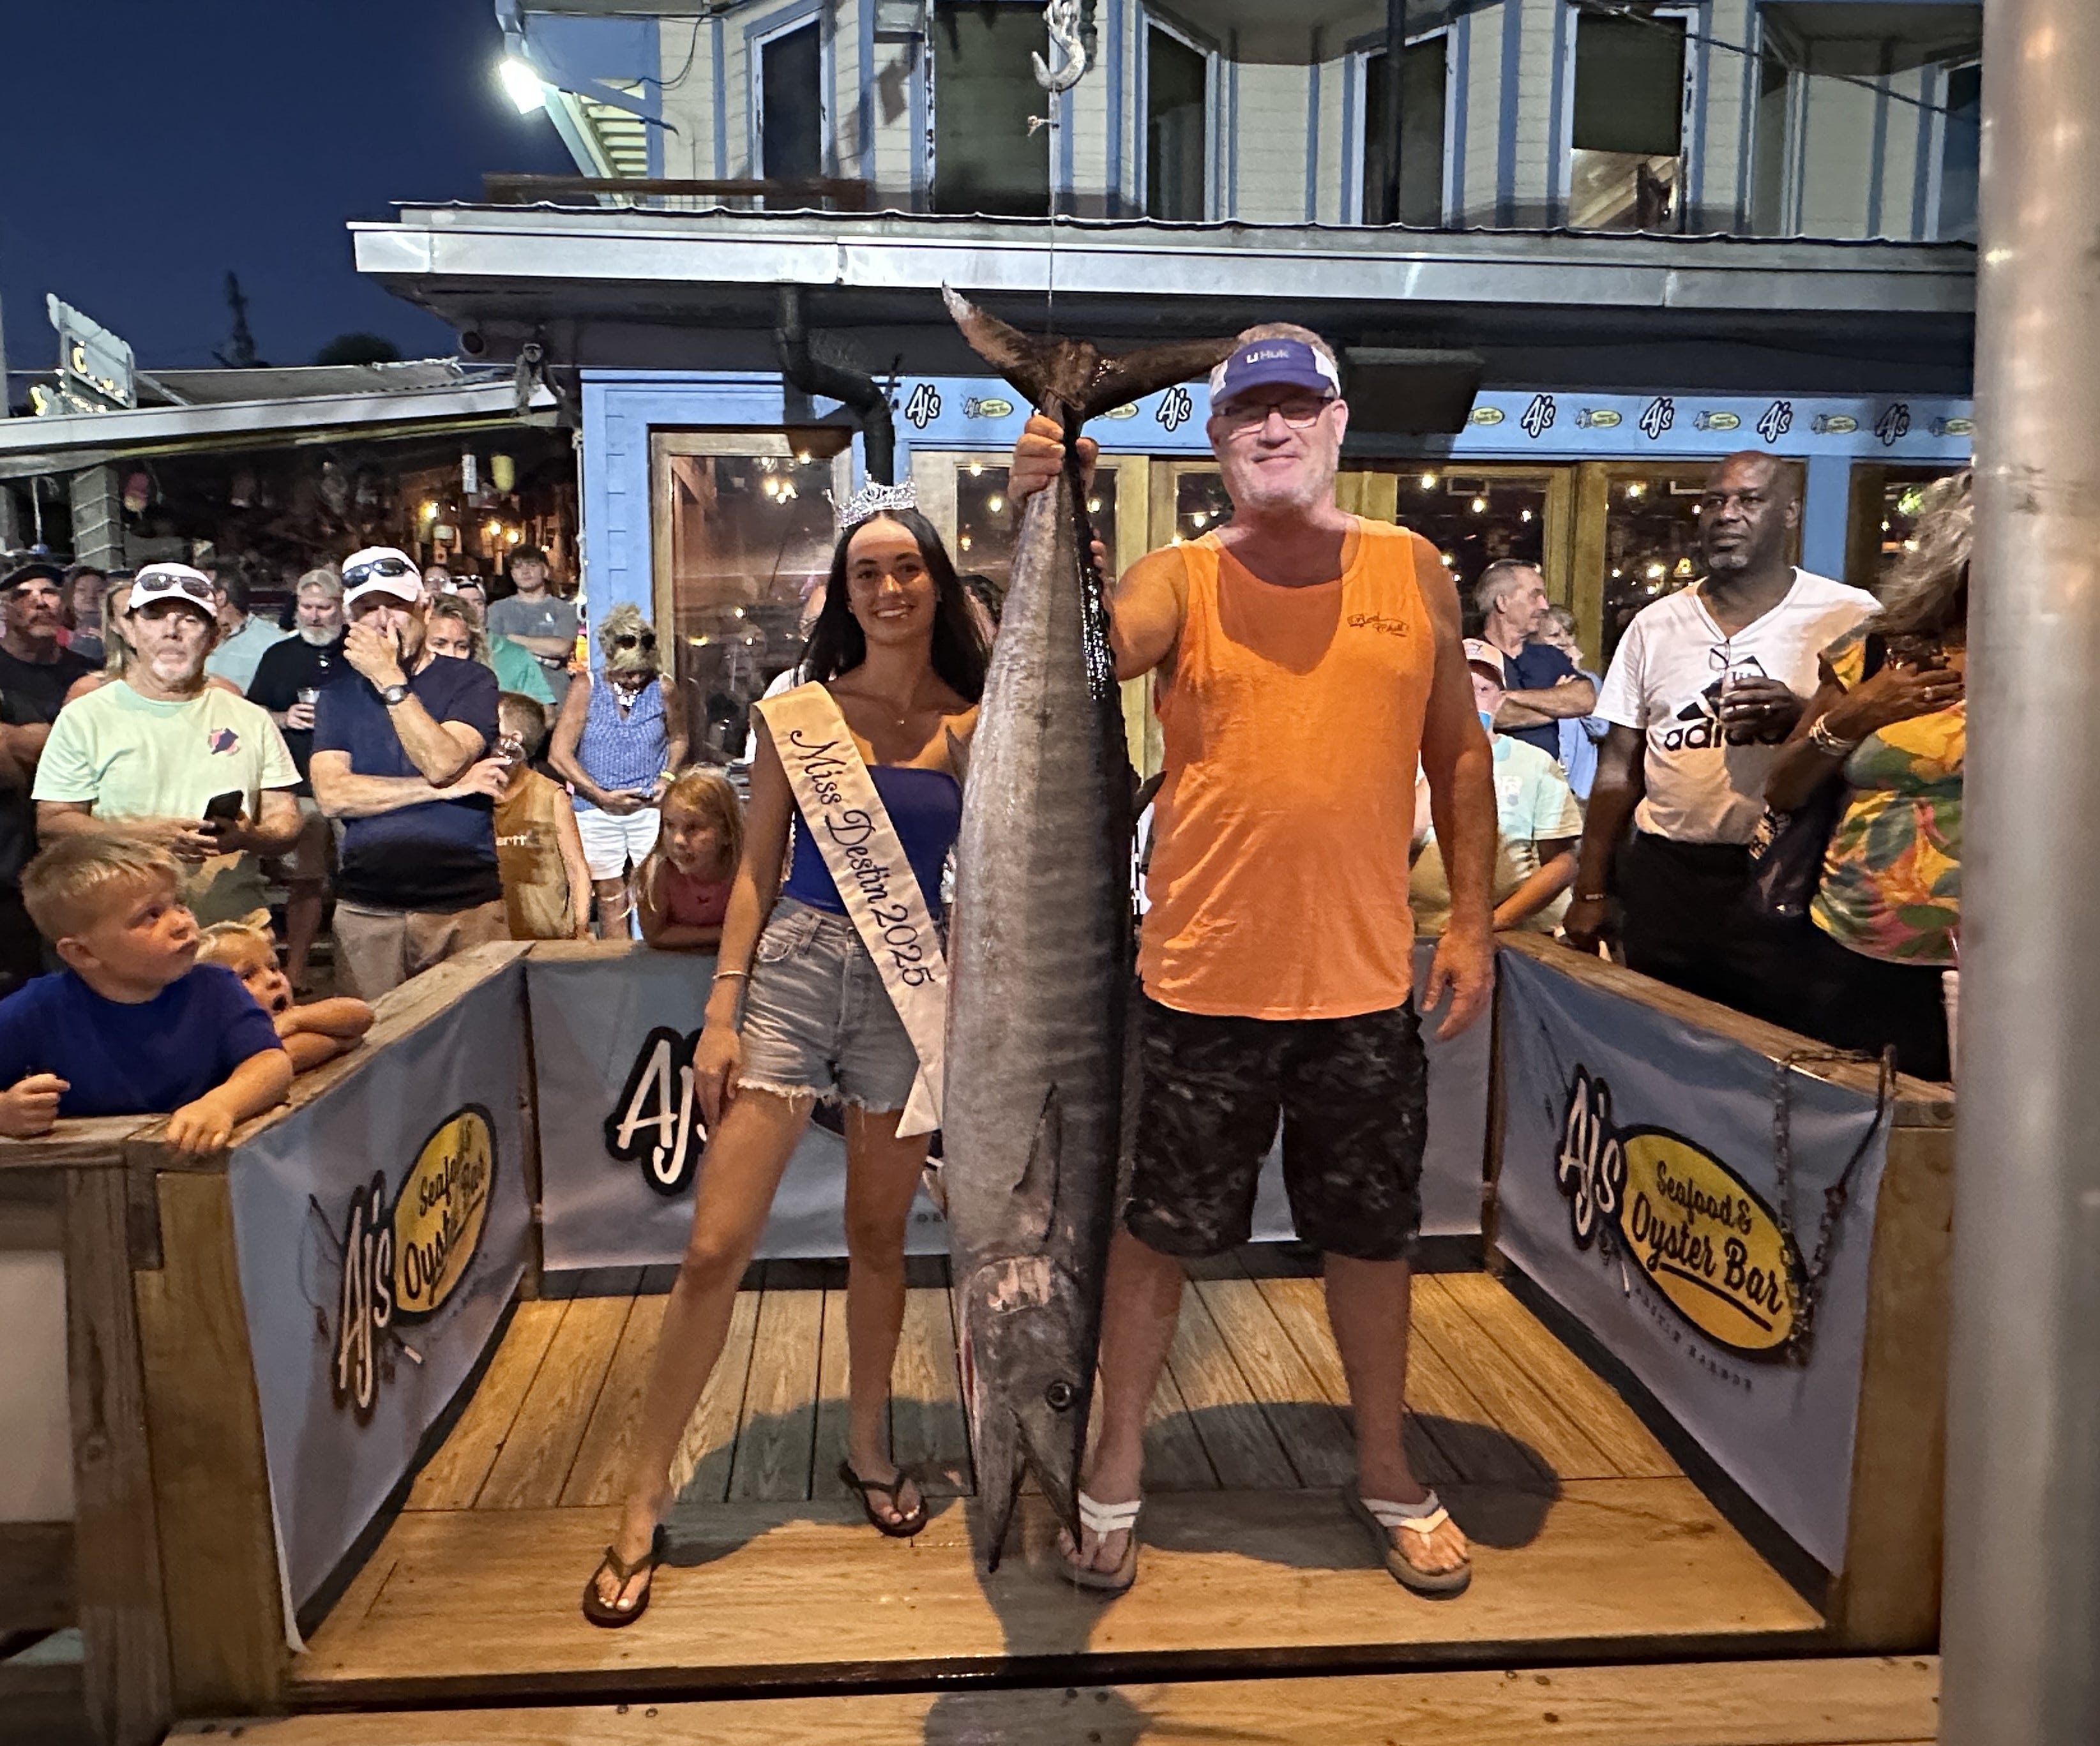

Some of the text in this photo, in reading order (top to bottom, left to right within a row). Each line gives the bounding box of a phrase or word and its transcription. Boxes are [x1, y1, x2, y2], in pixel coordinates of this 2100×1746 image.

[790, 730, 935, 986] Miss Destin 2025
[1631, 1191, 1717, 1277] Oyster
[1724, 1237, 1784, 1316] Bar
[1657, 1160, 1752, 1235] Seafood &
